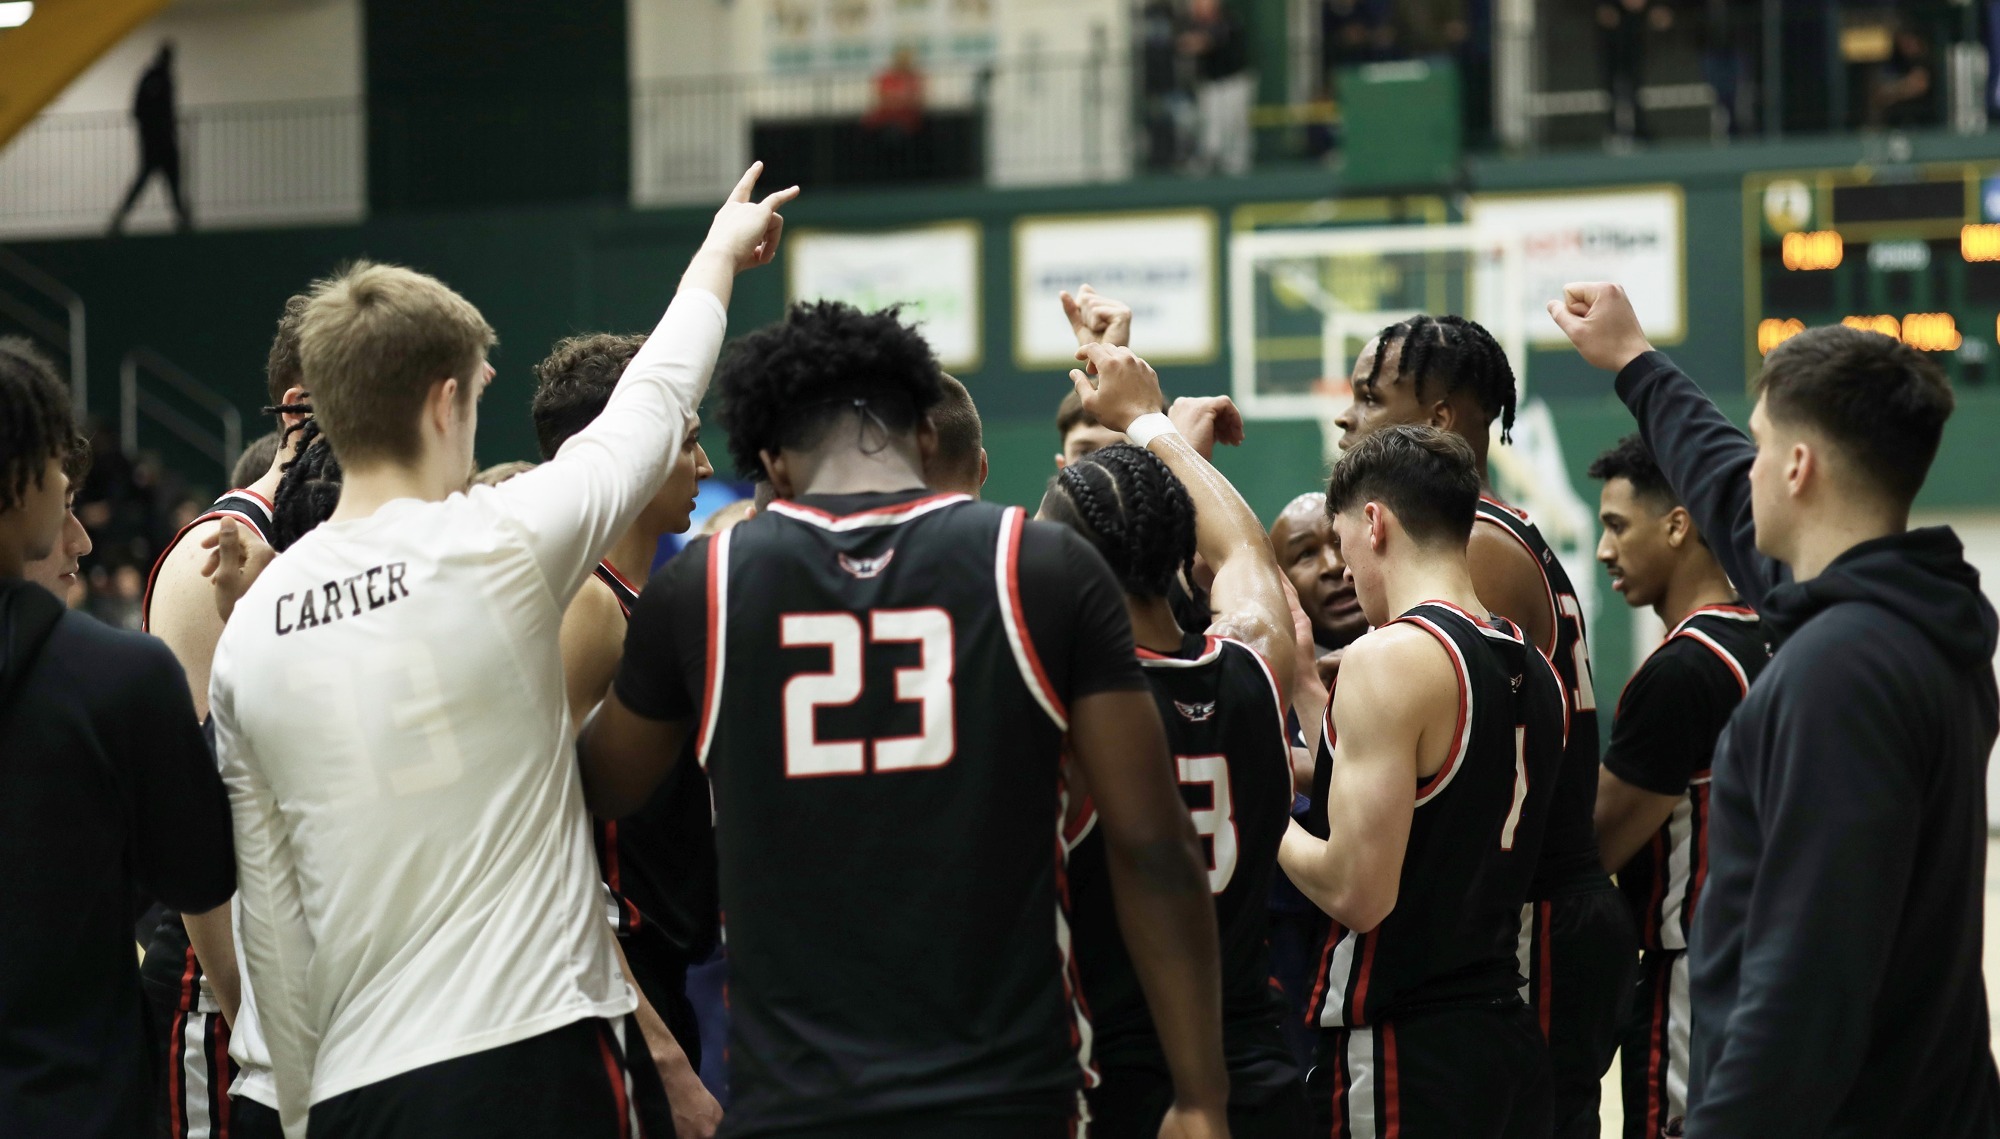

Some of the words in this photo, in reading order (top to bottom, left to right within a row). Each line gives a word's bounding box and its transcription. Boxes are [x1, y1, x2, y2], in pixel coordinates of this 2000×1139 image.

[275, 562, 410, 636] CARTER
[779, 605, 957, 779] 23
[1174, 754, 1240, 895] 3
